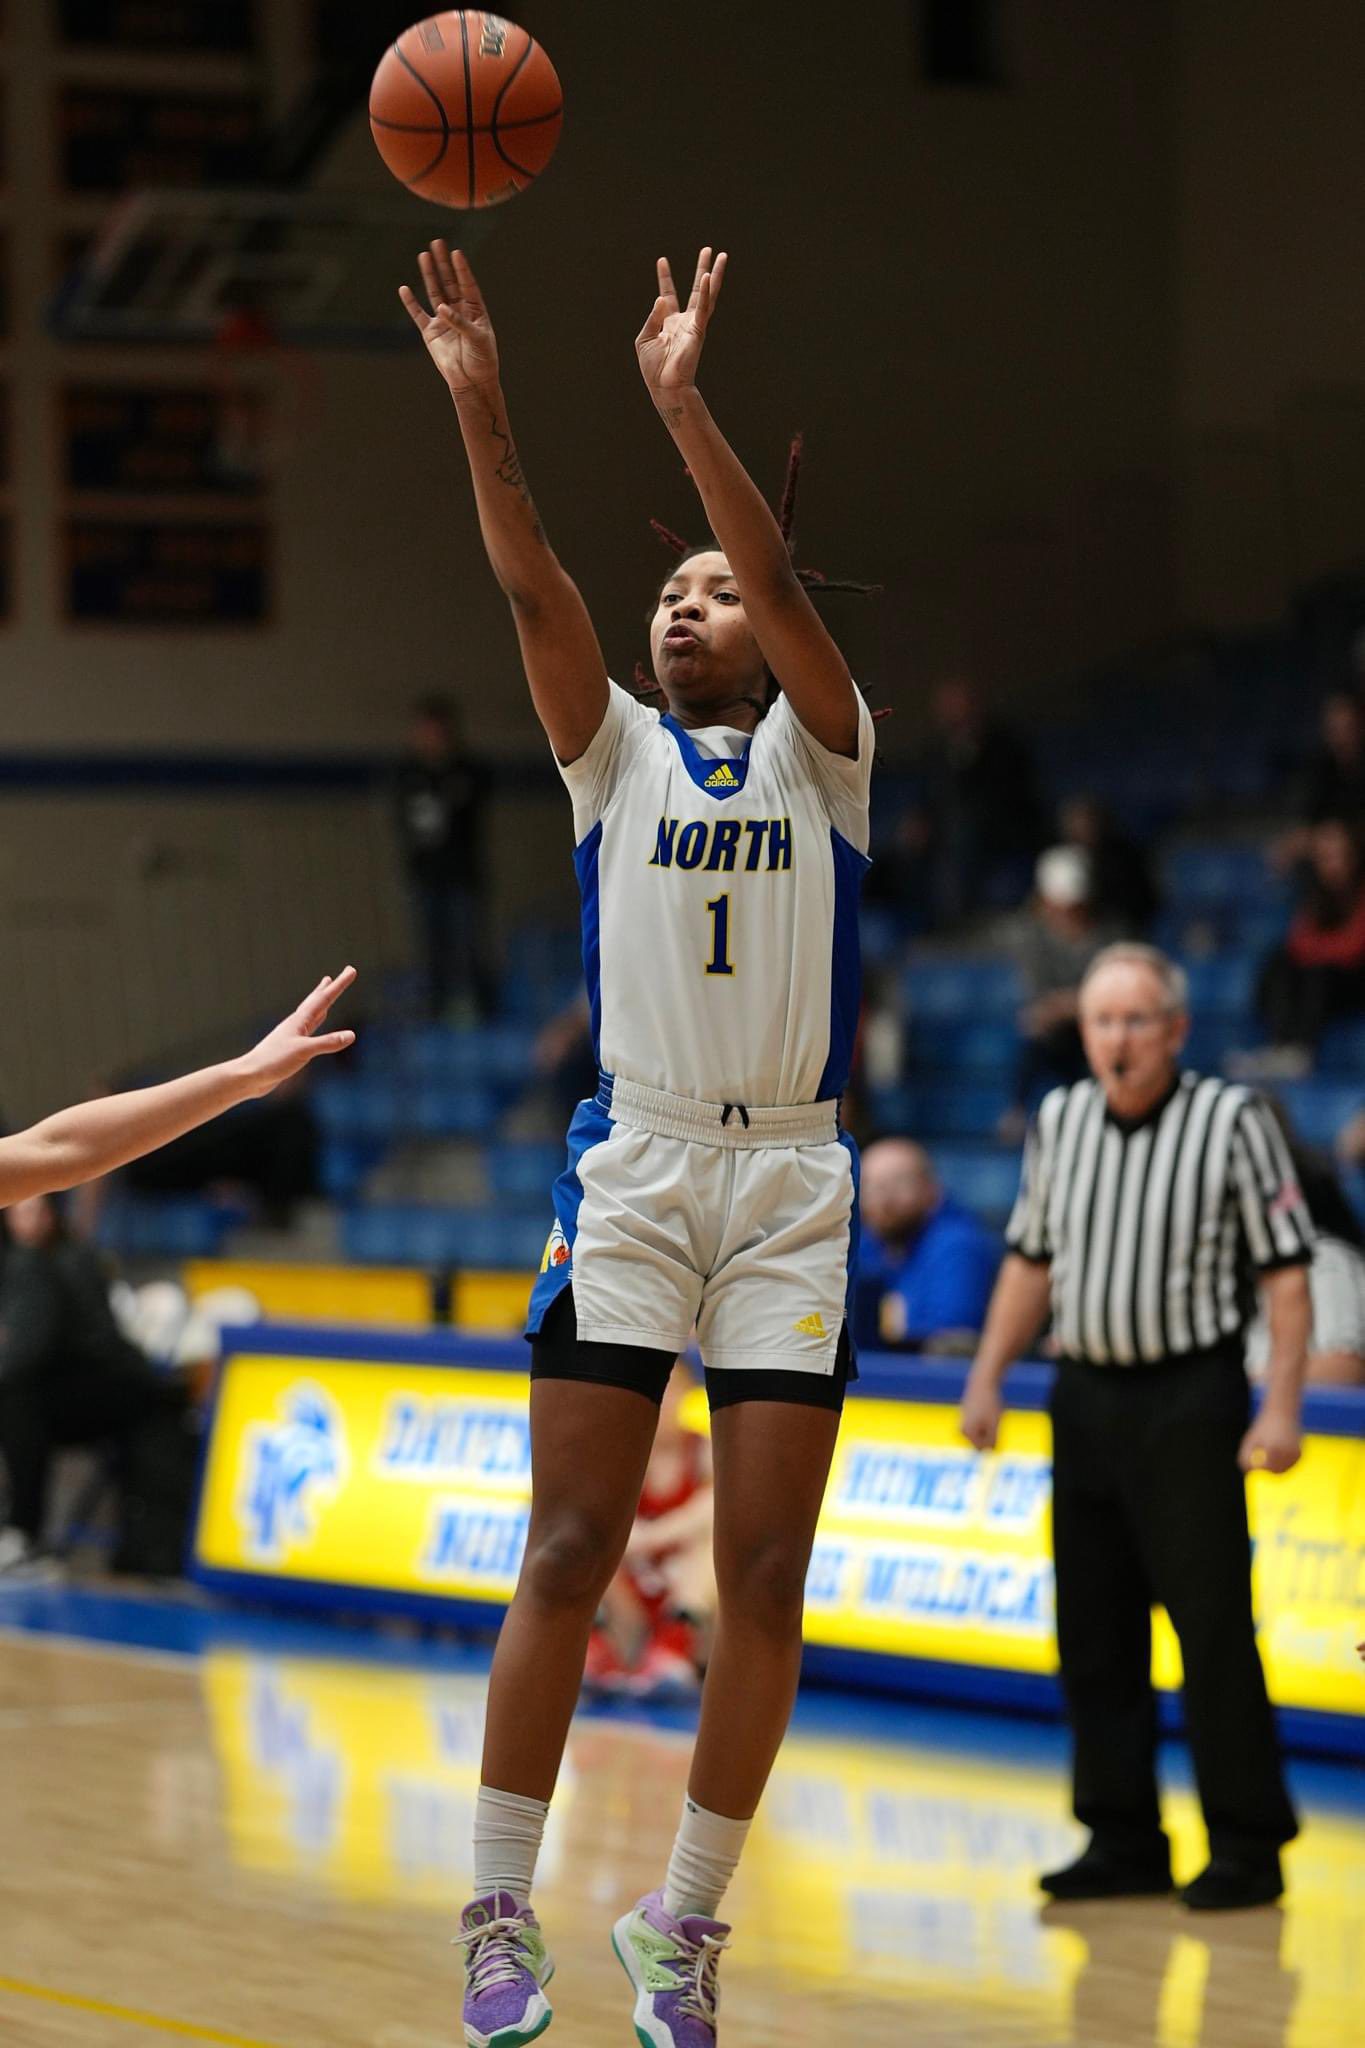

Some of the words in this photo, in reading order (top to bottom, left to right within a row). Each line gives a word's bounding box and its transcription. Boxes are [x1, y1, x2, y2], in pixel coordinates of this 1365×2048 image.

[704, 779, 739, 788] adidas
[648, 816, 793, 872] NORTH
[705, 891, 735, 976] 1
